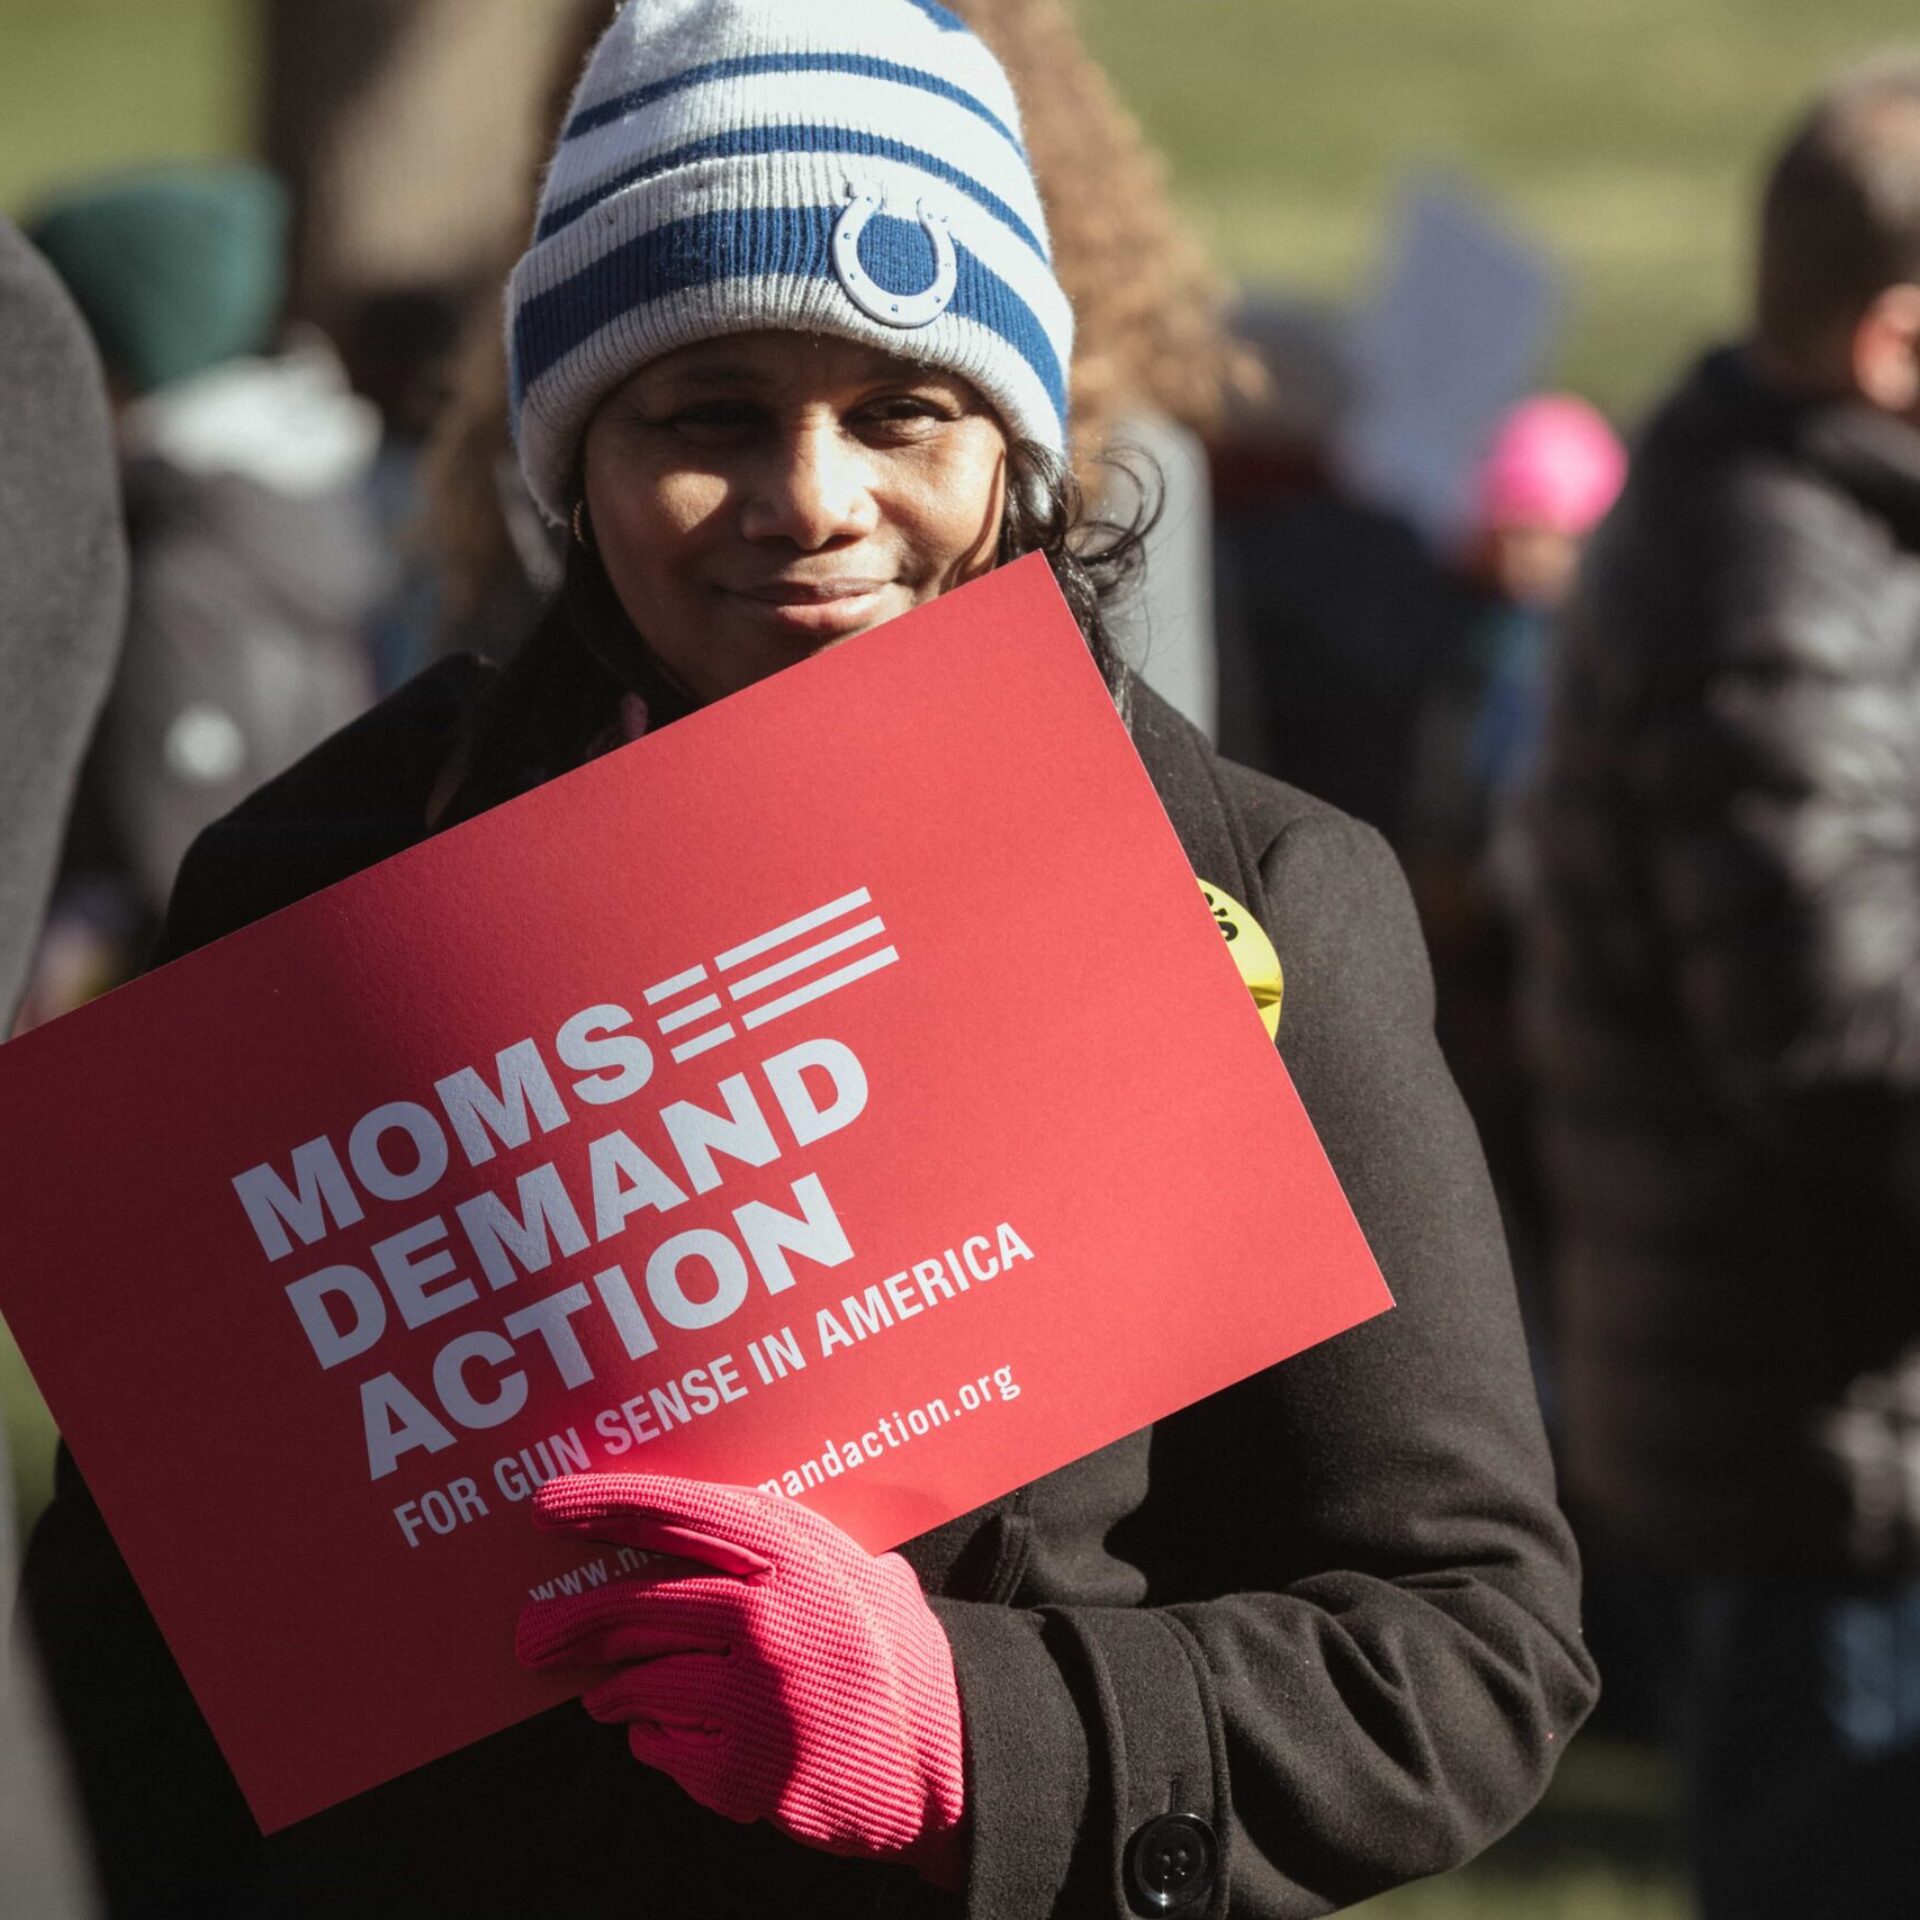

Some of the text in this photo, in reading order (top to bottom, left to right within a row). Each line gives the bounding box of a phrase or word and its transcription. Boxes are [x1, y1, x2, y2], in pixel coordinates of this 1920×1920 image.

[231, 1003, 655, 1262] MOMS
[285, 1037, 869, 1370] DEMAND
[359, 1171, 855, 1481] ACTION
[393, 1221, 1035, 1548] FOR GUN SENSE IN AMERICA
